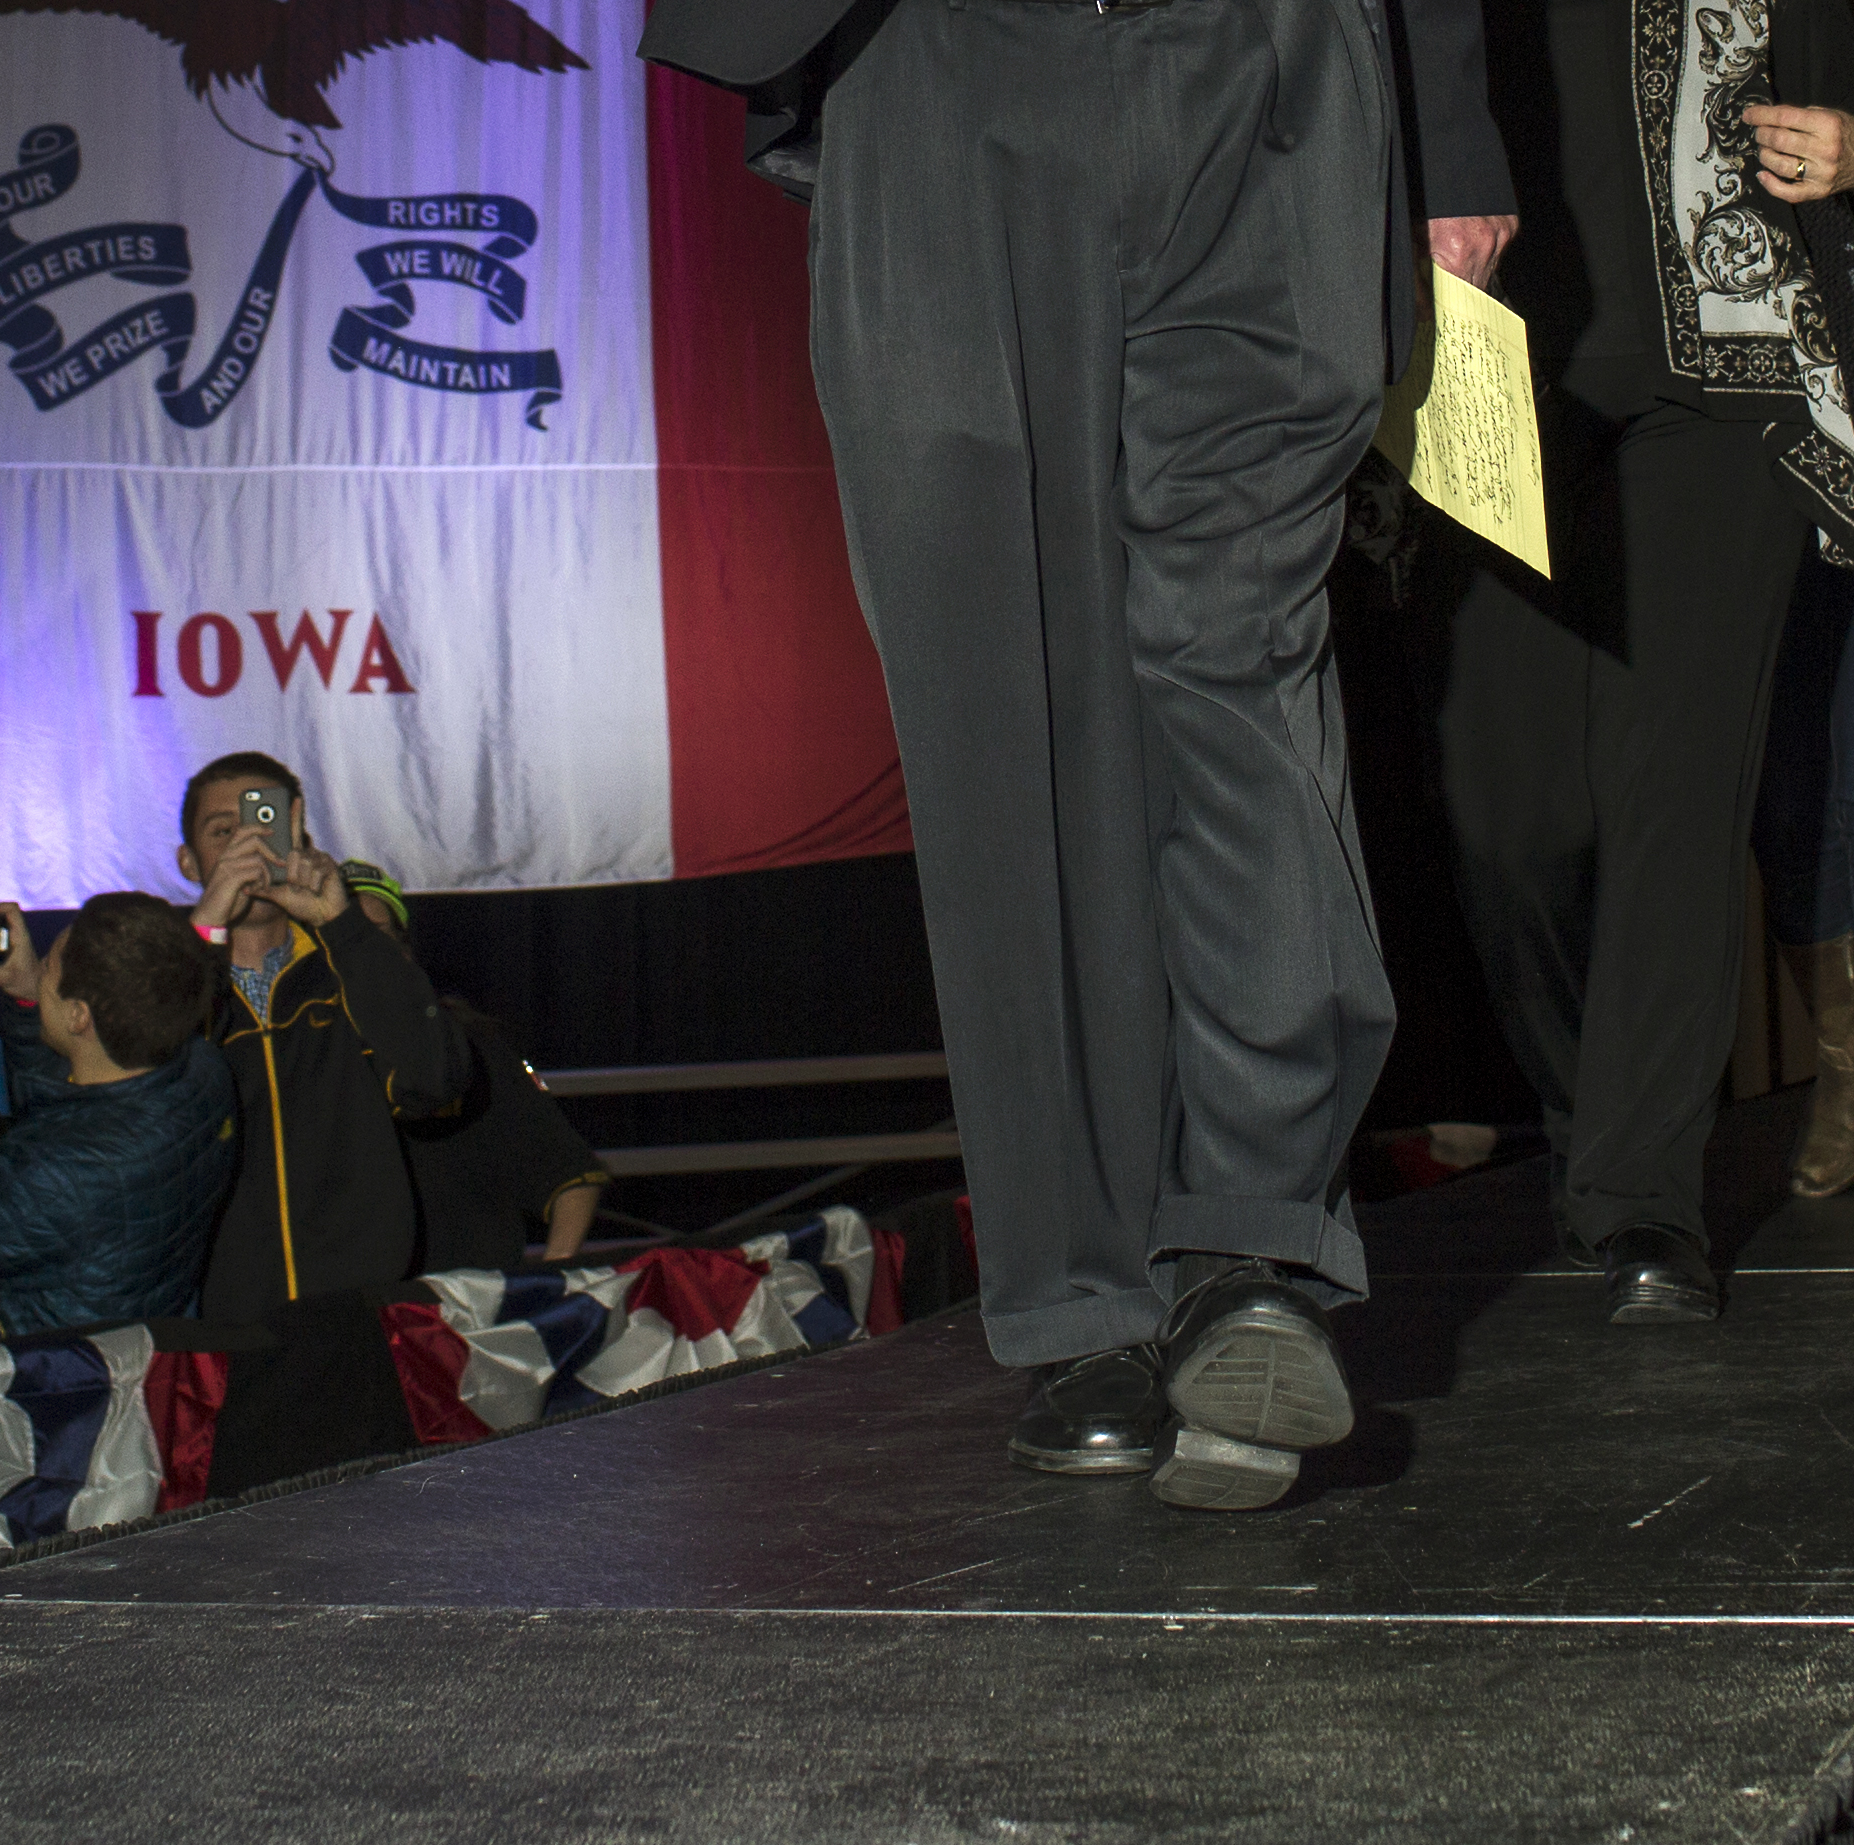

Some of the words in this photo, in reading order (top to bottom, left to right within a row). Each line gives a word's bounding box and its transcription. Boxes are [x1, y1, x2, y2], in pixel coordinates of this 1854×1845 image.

[387, 200, 501, 228] RIGHTS
[383, 248, 431, 278] WE
[439, 251, 506, 296] WILL
[37, 358, 88, 401] WE
[90, 309, 169, 371] PRIZE
[199, 357, 246, 415] AND
[232, 284, 275, 354] OUR
[362, 336, 513, 390] MAINTAIN
[131, 610, 417, 699] IOWA
